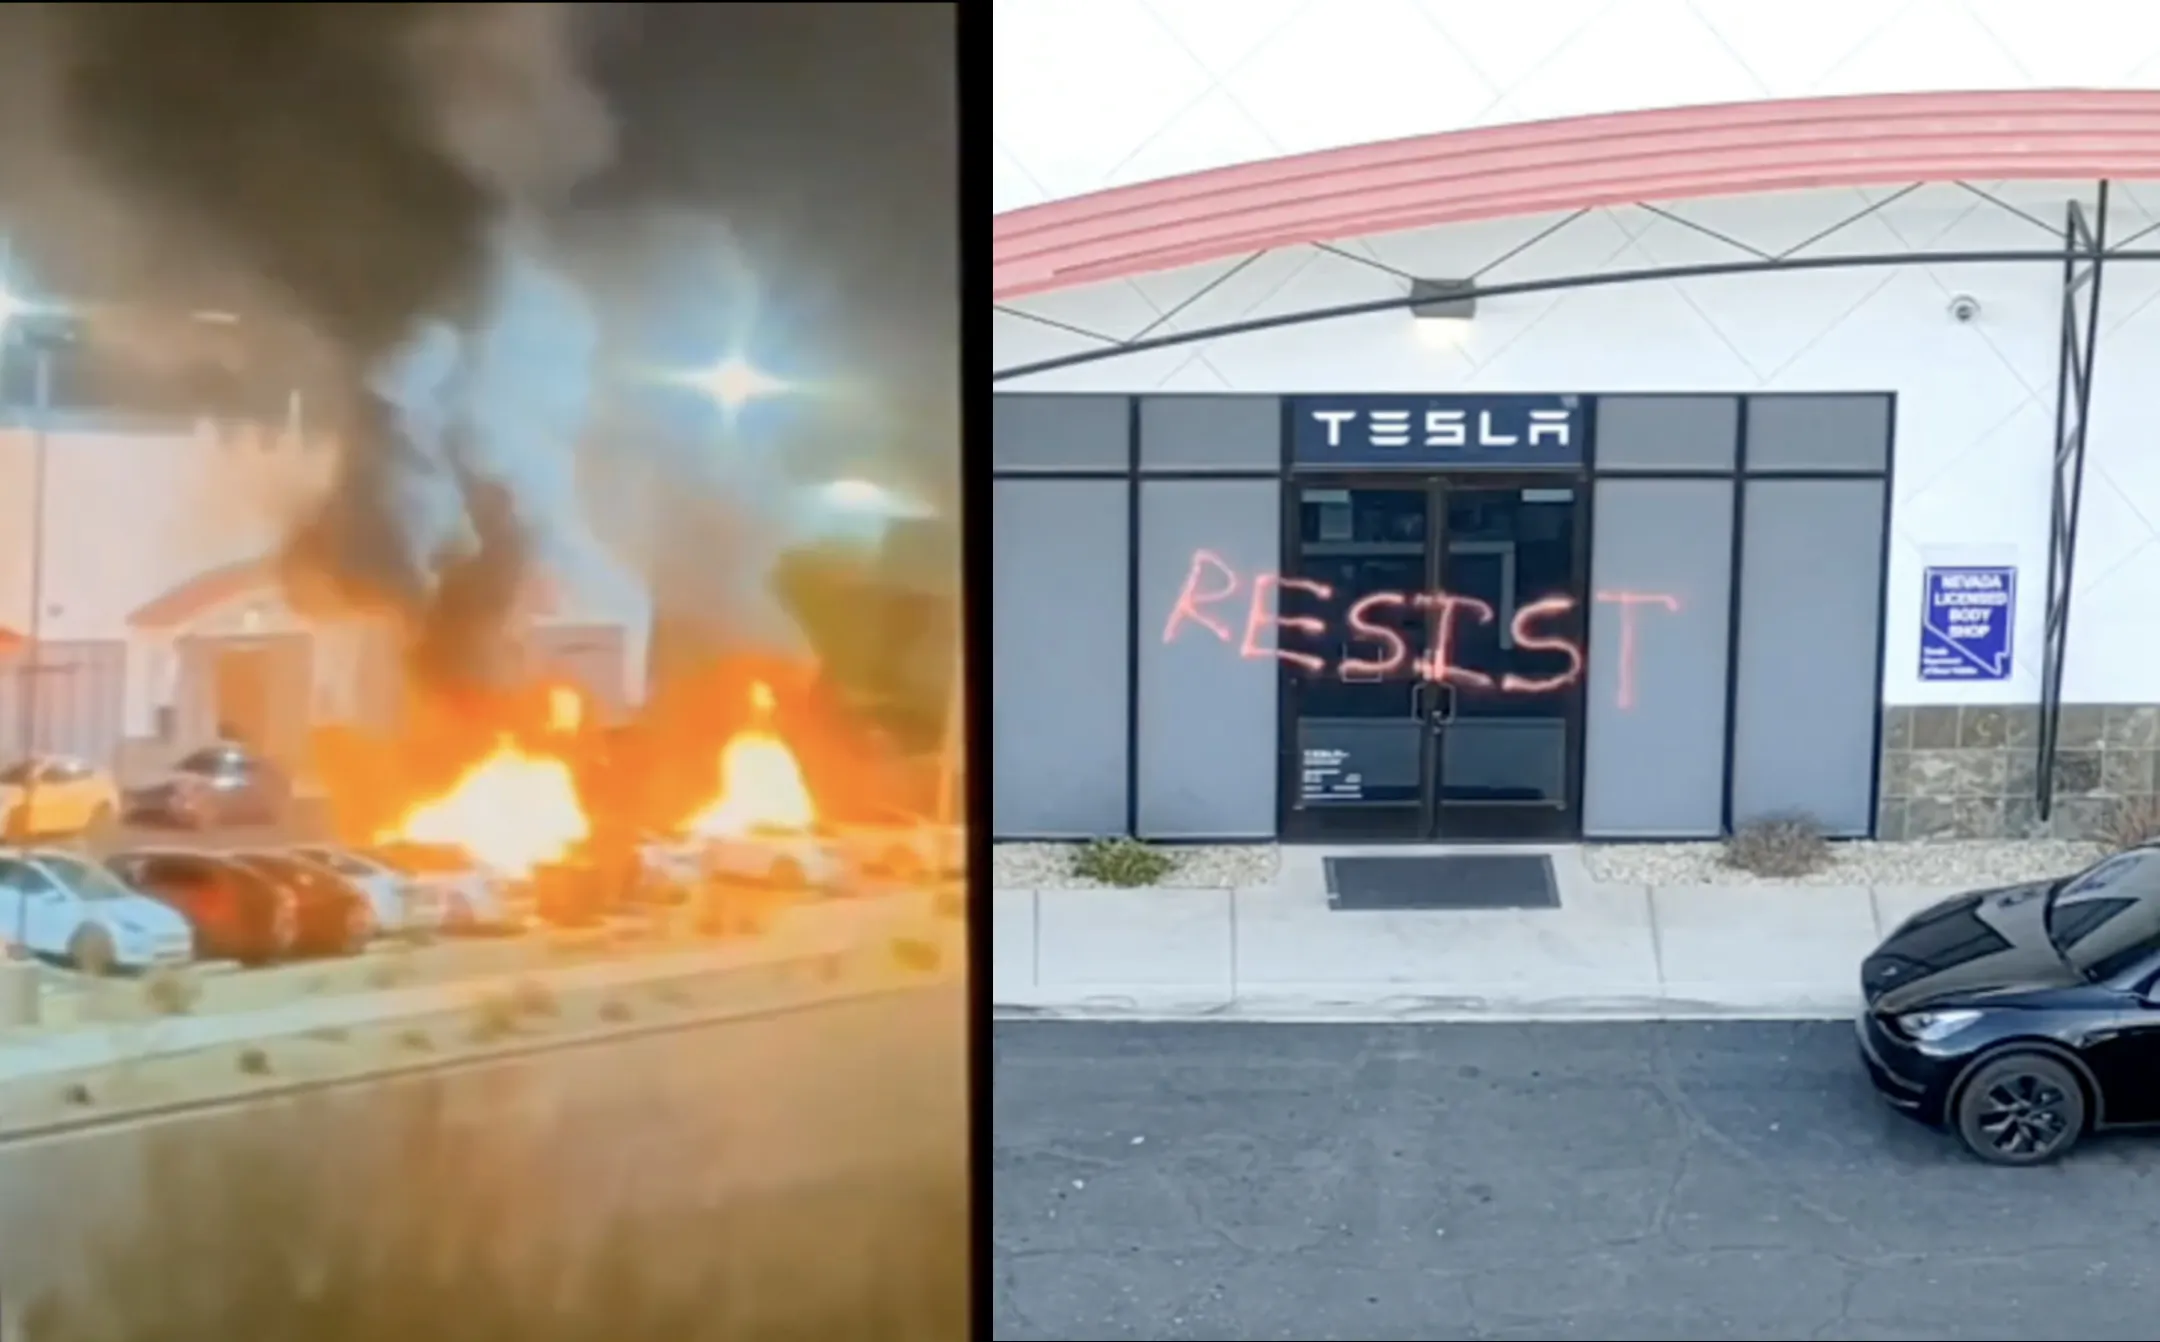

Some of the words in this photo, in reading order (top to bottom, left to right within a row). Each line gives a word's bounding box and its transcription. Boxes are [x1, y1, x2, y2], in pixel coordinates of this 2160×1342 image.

[1311, 410, 1570, 446] TESLA
[1948, 607, 1992, 622] BODY
[1162, 548, 1679, 708] RESIST
[1948, 624, 1991, 639] SHOP
